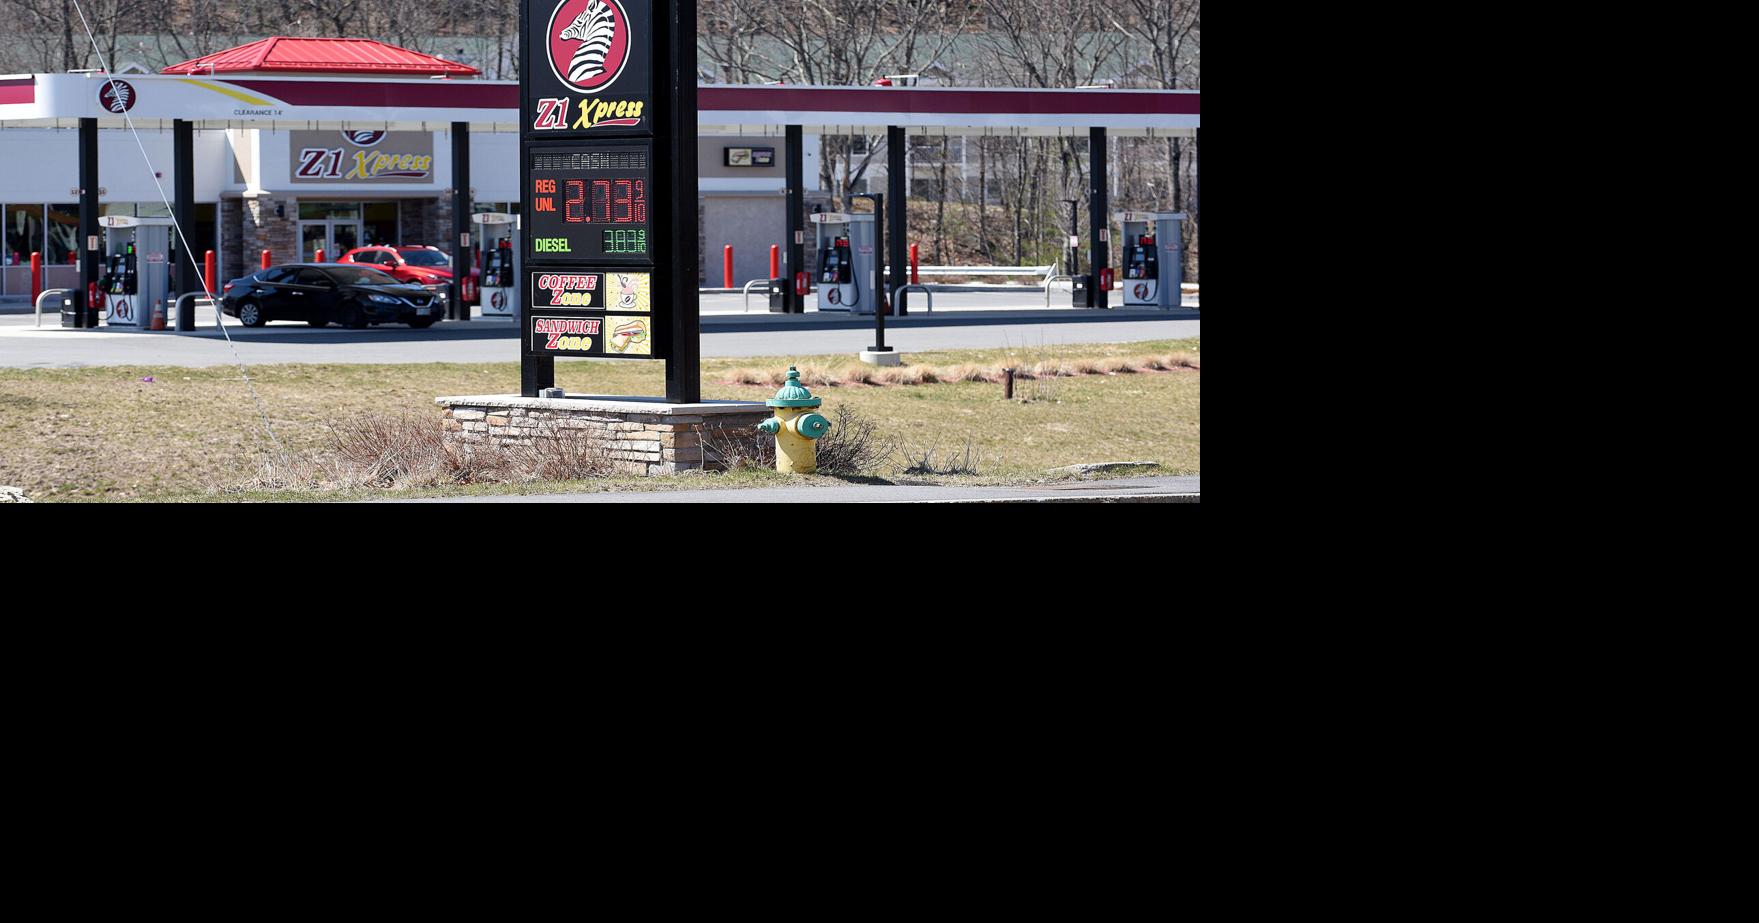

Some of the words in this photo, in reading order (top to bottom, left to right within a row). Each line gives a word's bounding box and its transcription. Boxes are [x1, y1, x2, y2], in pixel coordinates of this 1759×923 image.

[534, 96, 570, 130] Z1
[572, 98, 644, 130] Xpress
[296, 147, 344, 179] Z1
[344, 150, 432, 180] Xpress
[535, 179, 556, 193] REG
[535, 197, 556, 212] UNL
[535, 238, 571, 252] DIESEL
[538, 274, 598, 290] COFFEE
[550, 288, 591, 306] Zone
[535, 318, 600, 335] SANDWICH
[545, 333, 592, 351] Zone
